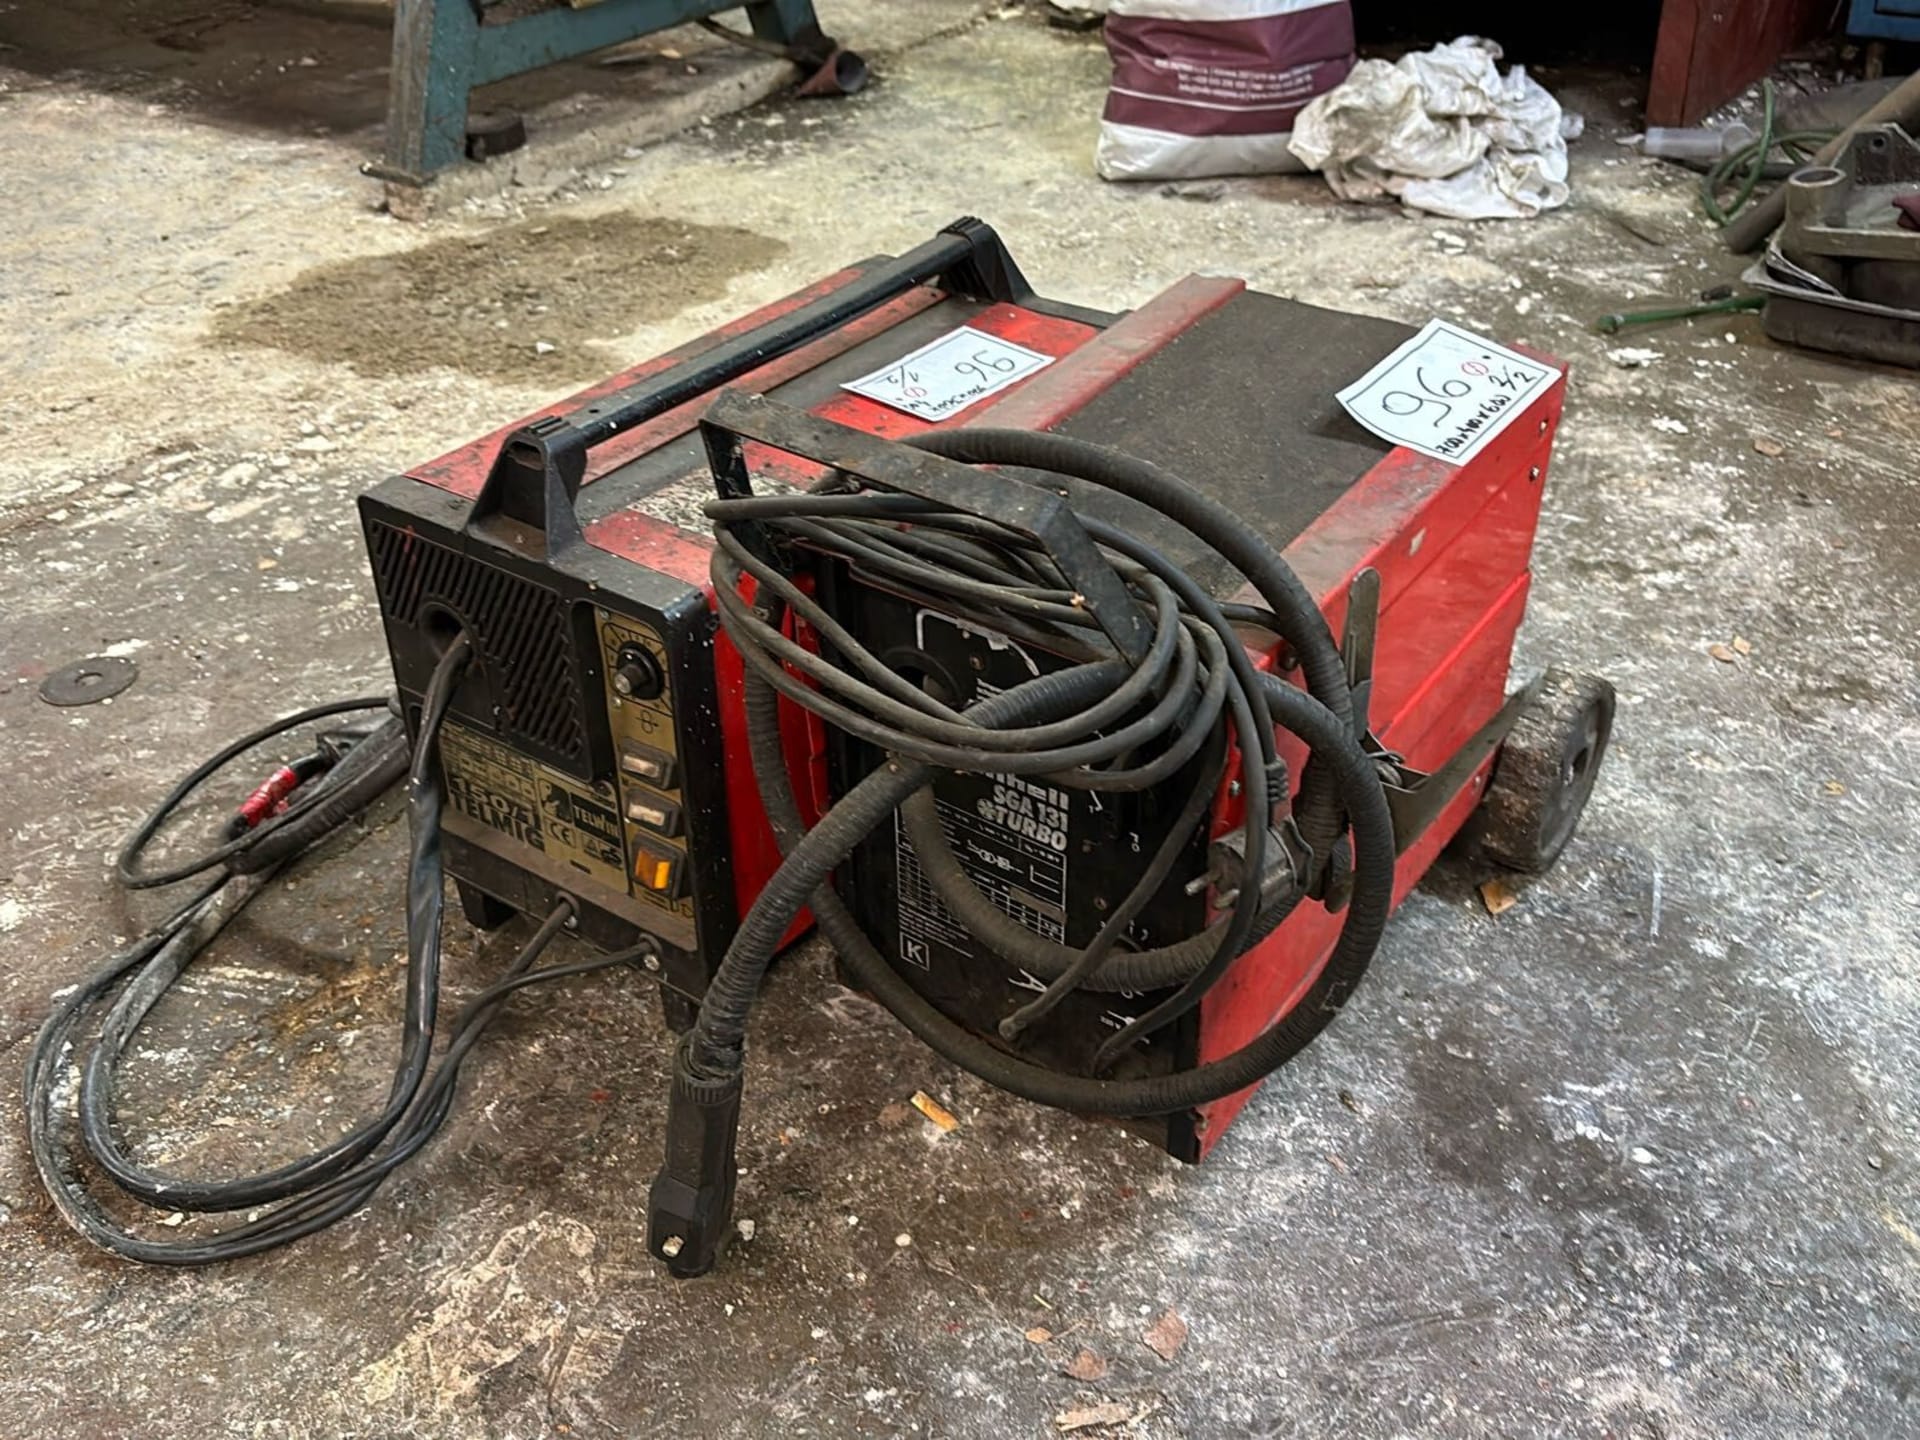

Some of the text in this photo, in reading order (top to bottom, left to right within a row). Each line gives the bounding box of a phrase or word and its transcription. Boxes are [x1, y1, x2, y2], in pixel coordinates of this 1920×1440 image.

[954, 350, 1016, 383] 96
[1488, 364, 1538, 392] 2/2
[1382, 366, 1472, 428] 96
[449, 789, 546, 852] TELMIG
[993, 784, 1034, 818] SGA
[1037, 799, 1069, 832] 131
[994, 805, 1067, 851] TURBO
[906, 941, 923, 963] K
